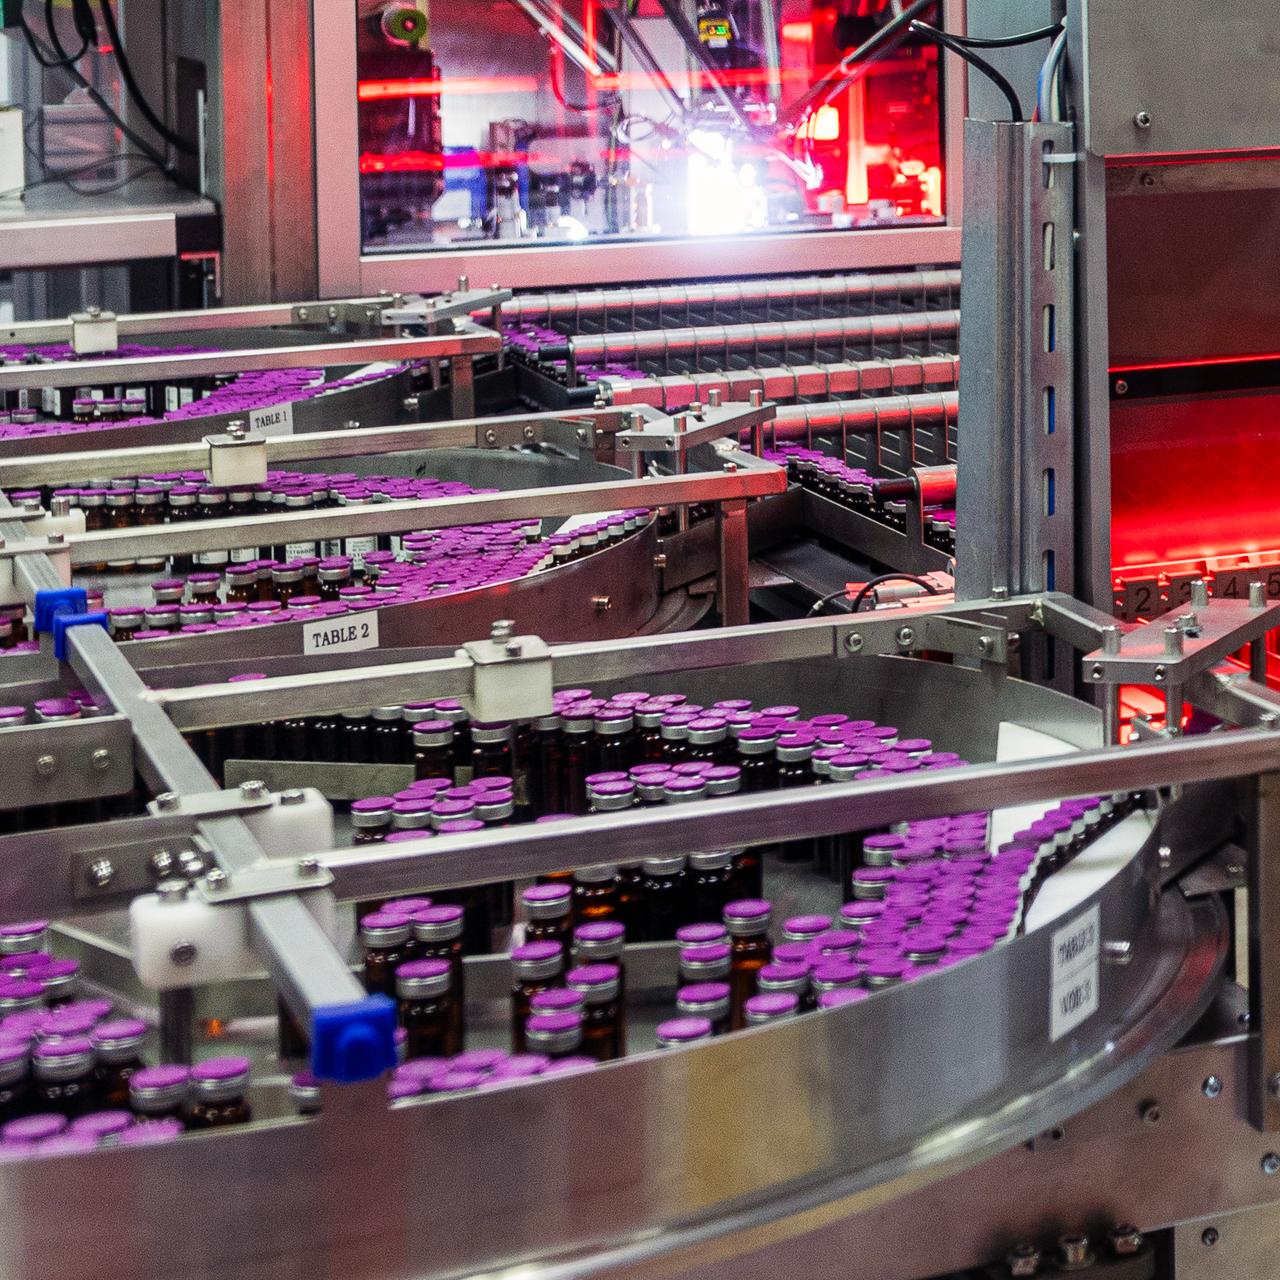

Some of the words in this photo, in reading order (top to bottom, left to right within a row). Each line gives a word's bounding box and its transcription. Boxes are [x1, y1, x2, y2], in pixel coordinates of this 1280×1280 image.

[255, 412, 281, 428] TABLE
[1135, 587, 1151, 612] 2
[1223, 577, 1239, 598] 4
[313, 626, 357, 648] TABLE
[361, 623, 369, 638] 2
